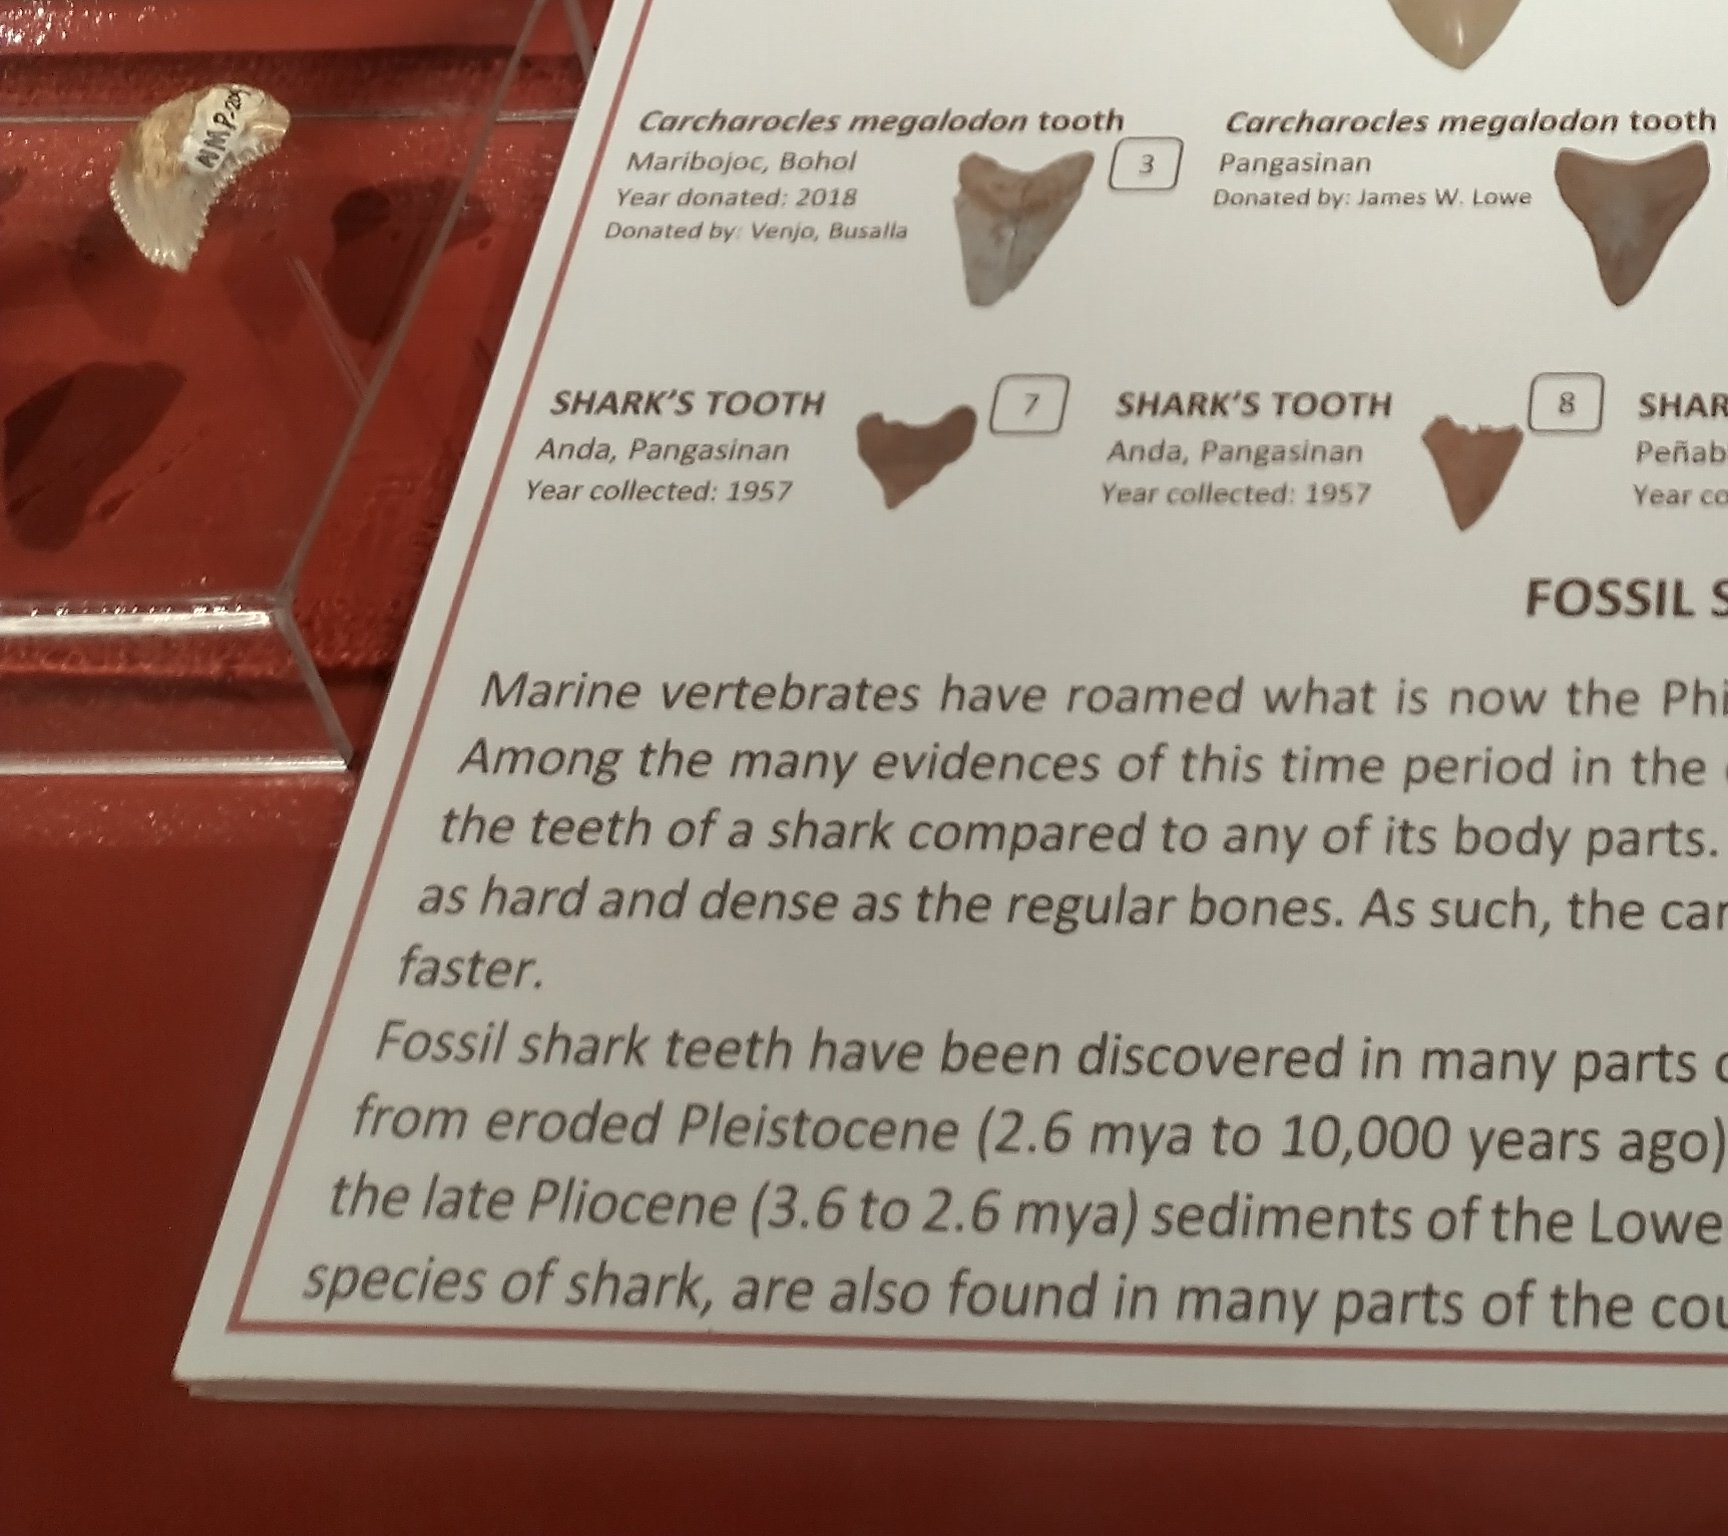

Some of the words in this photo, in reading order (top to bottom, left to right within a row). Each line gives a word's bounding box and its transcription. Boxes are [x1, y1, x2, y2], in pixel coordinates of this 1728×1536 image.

[638, 108, 841, 134] Carcharocles
[847, 107, 1029, 139] megalodon
[1038, 107, 1125, 134] tooth
[1225, 108, 1429, 135] Carcharocles
[1437, 107, 1619, 139] megalodon
[1629, 107, 1717, 134] tooth
[626, 149, 769, 177] Maribojoc,
[779, 149, 858, 173] Bohol
[1138, 152, 1155, 177] 3
[1218, 151, 1372, 179] Pangasinan
[617, 187, 671, 208] Year
[676, 187, 788, 209] donated:
[795, 187, 858, 209] 2018
[1212, 187, 1311, 208] Donated
[1316, 187, 1351, 212] by:
[1357, 188, 1427, 208] James
[1434, 187, 1460, 208] W.
[1472, 188, 1533, 208] Lowe
[604, 220, 705, 241] Donated
[708, 220, 743, 244] by:
[751, 221, 819, 245] Venjo,
[706, 389, 826, 418] TOOTH
[1024, 392, 1041, 418] 7
[1272, 391, 1393, 420] TOOTH
[1557, 390, 1576, 417] 8
[535, 436, 617, 466] Anda,
[628, 437, 790, 468] Pangasinan
[1106, 437, 1189, 468] Anda,
[1200, 438, 1364, 470] Pangasinan
[527, 478, 585, 502] Year
[588, 477, 718, 503] collected:
[726, 479, 794, 503] 1957
[1101, 481, 1160, 506] Year
[1165, 480, 1295, 507] collected:
[1305, 481, 1372, 507] 1957
[1633, 483, 1693, 508] Year
[1526, 577, 1696, 619] FOSSIL
[480, 669, 642, 711] Marine
[661, 671, 921, 713] vertebrates
[939, 672, 1047, 714] have
[1066, 674, 1245, 716] roamed
[1263, 675, 1377, 717] what
[1396, 677, 1428, 717] is
[1449, 686, 1548, 718] now
[1566, 676, 1641, 718] the
[302, 1255, 487, 1313] species
[500, 1255, 560, 1306] of
[564, 1258, 713, 1319] shark,
[731, 1274, 815, 1313] are
[829, 1265, 931, 1316] also
[948, 1265, 1100, 1320] found
[1113, 1272, 1158, 1321] in
[1176, 1285, 1320, 1336] many
[1333, 1281, 1464, 1337] parts
[1482, 1276, 1538, 1328] of
[1549, 1277, 1634, 1330] the
